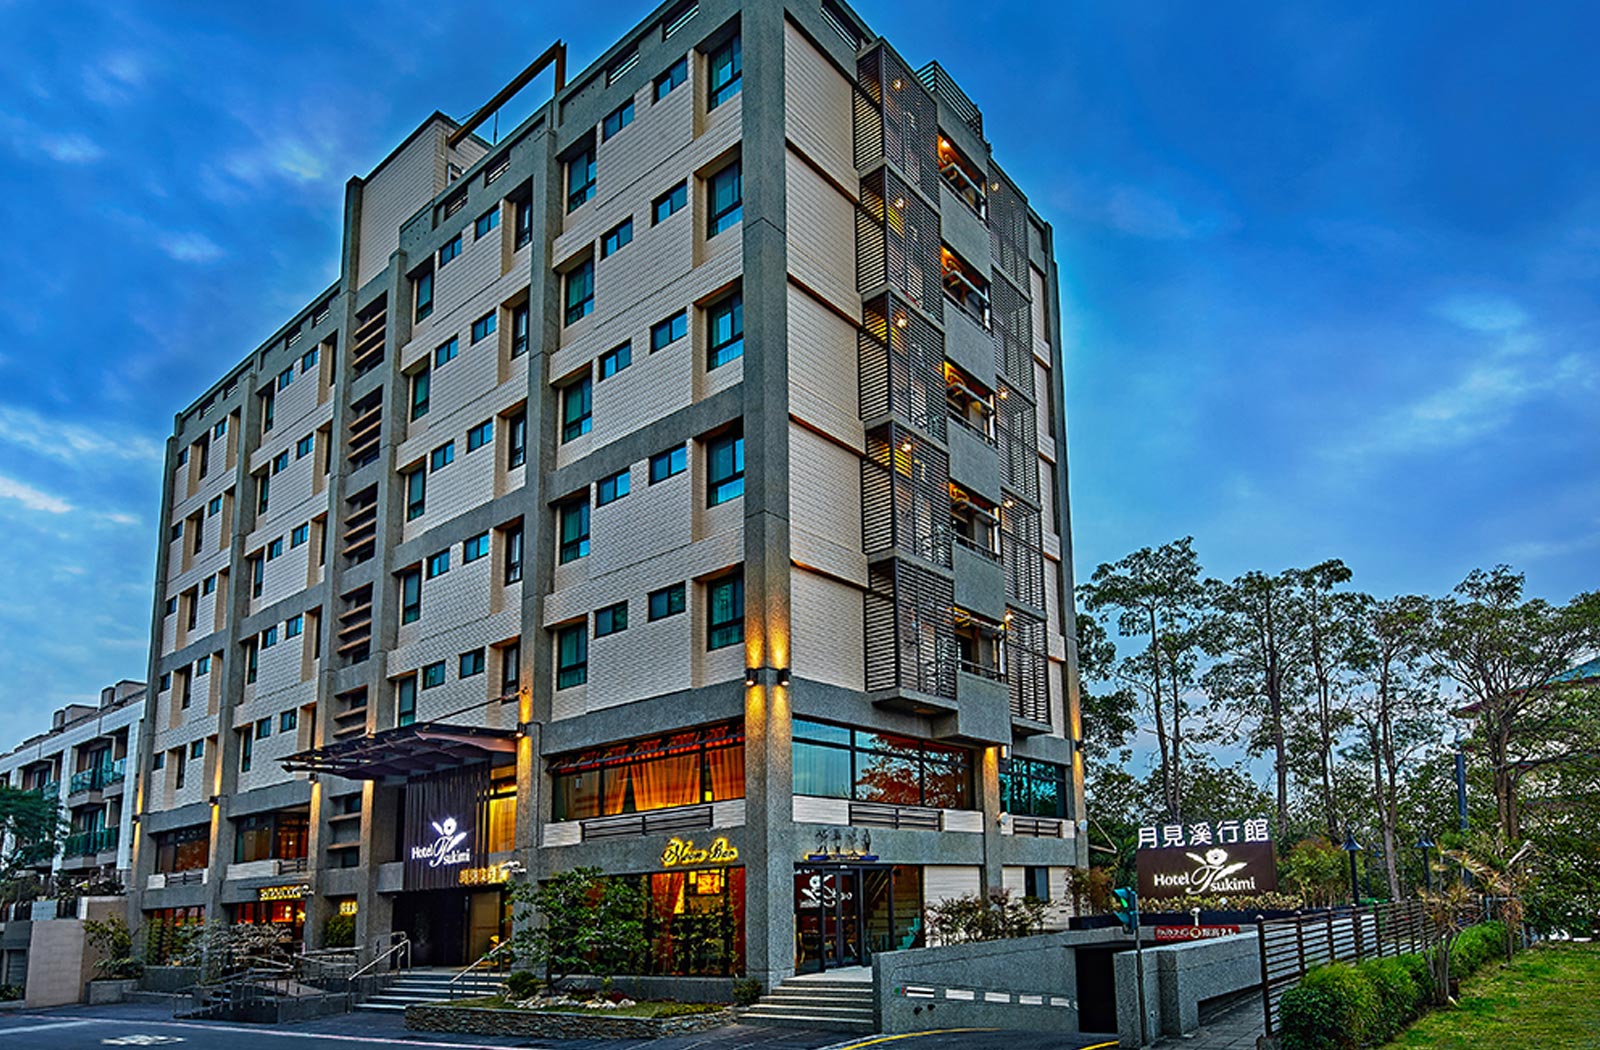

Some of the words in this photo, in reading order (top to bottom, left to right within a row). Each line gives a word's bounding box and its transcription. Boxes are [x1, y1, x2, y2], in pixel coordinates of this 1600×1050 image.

[1137, 818, 1269, 849] 月見溪行館
[411, 844, 432, 859] Hotel
[1154, 873, 1190, 887] Hotel
